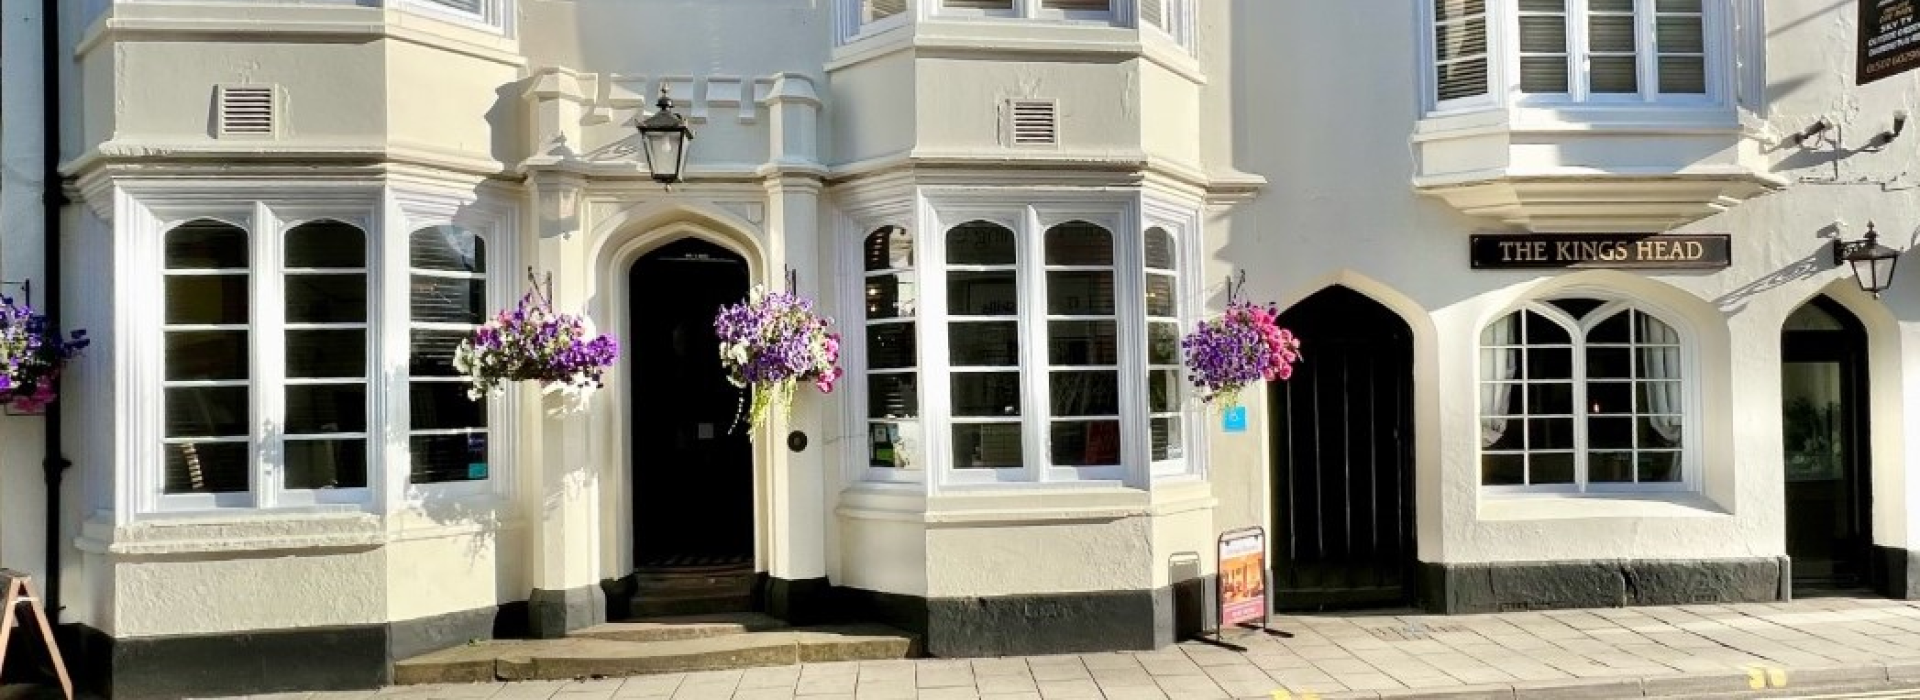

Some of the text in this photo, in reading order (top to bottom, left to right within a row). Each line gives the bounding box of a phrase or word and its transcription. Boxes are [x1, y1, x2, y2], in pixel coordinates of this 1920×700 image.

[1499, 241, 1704, 261] THE KINGS HEAD
